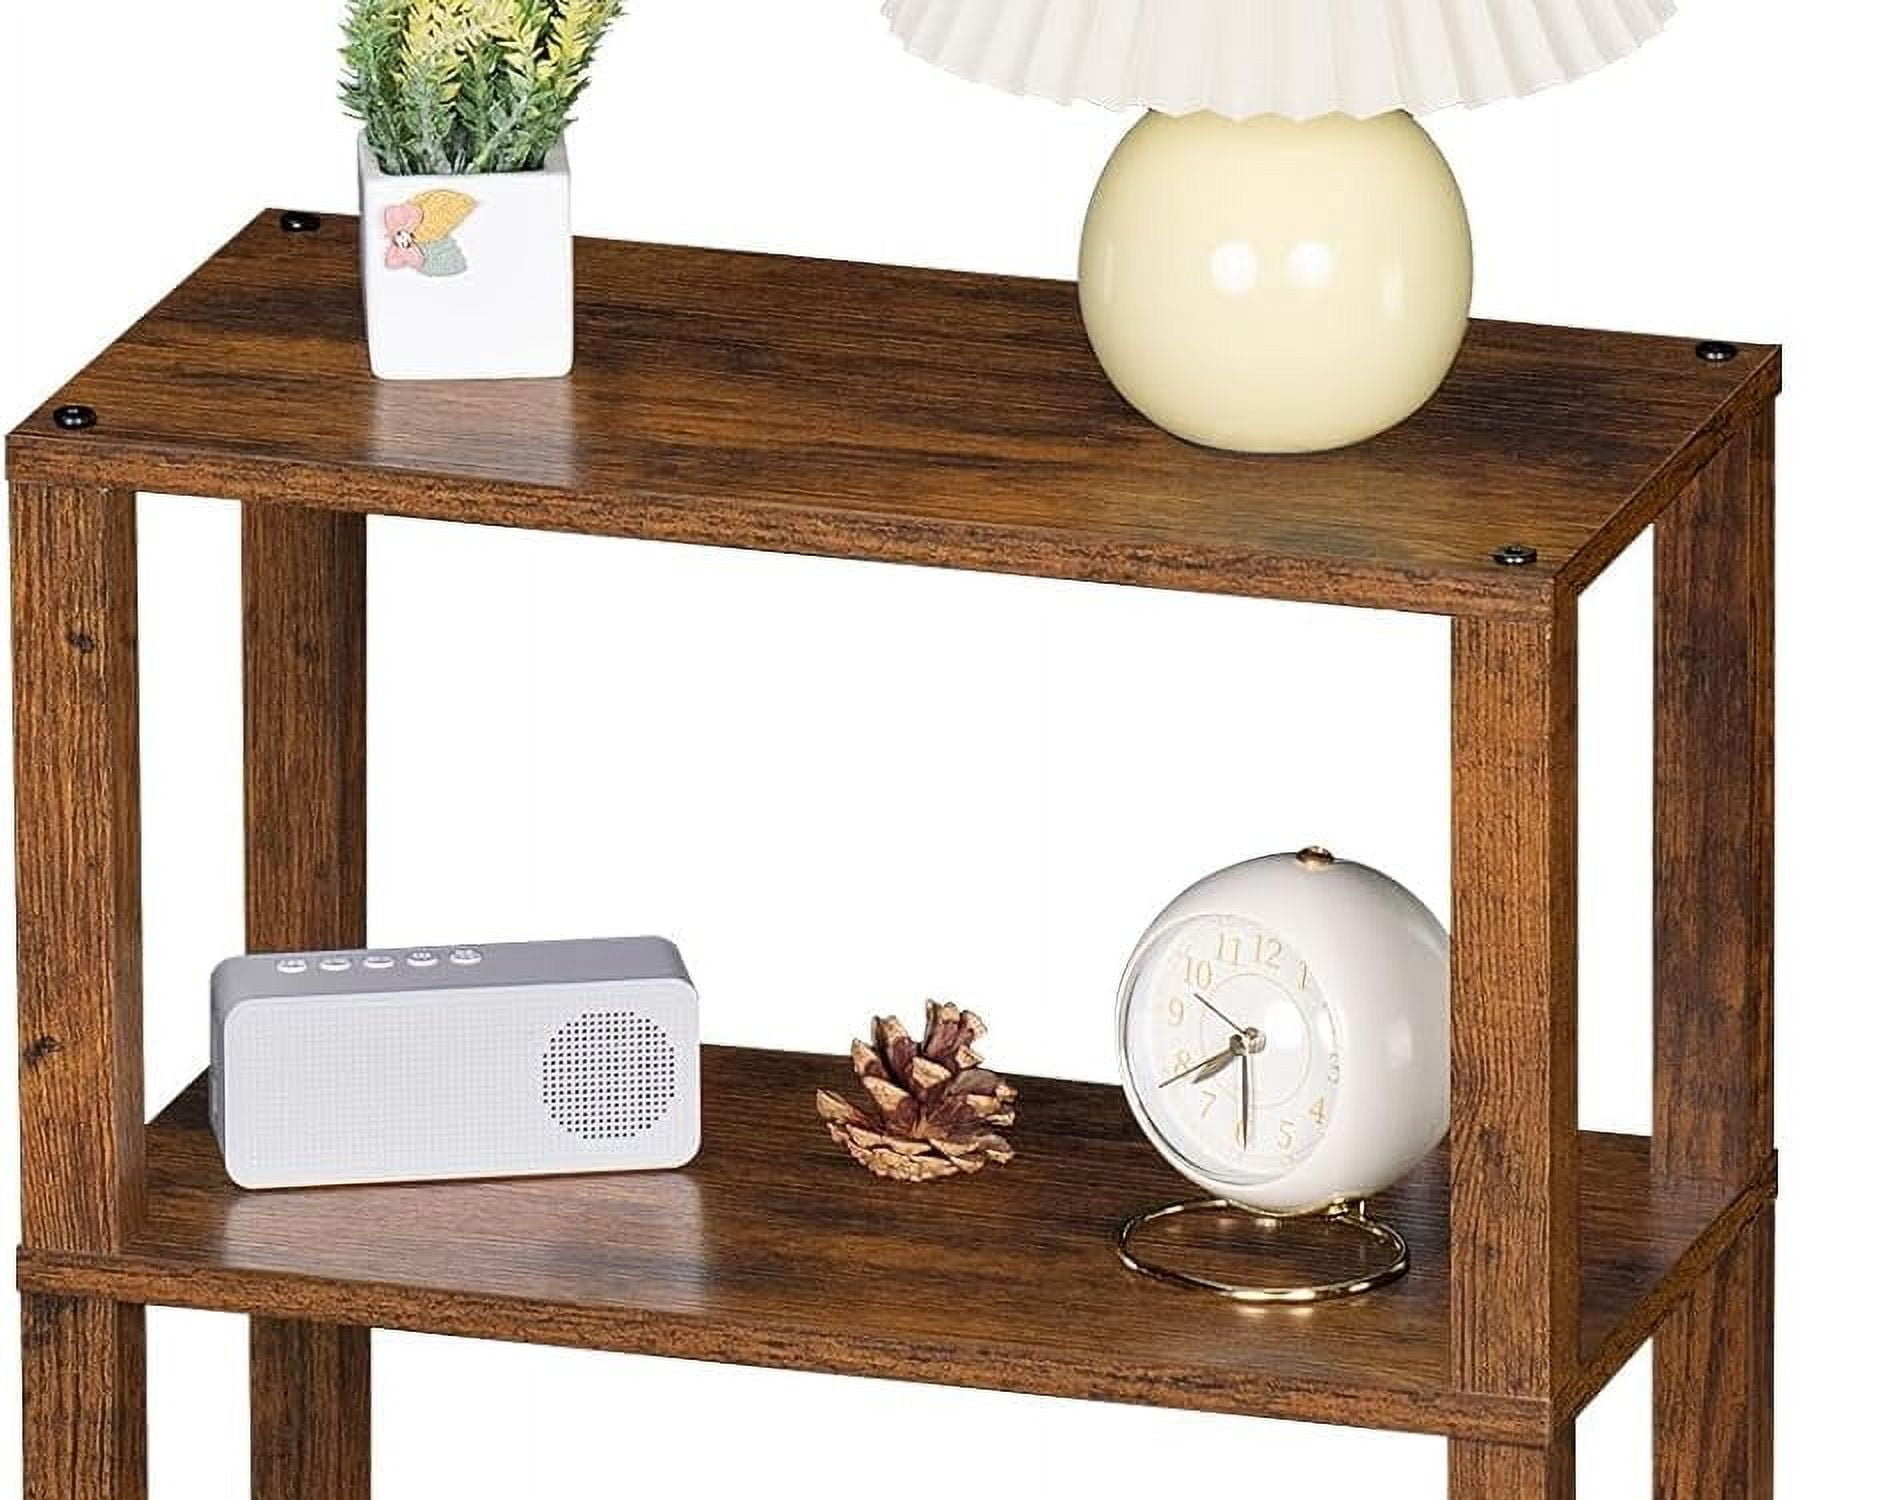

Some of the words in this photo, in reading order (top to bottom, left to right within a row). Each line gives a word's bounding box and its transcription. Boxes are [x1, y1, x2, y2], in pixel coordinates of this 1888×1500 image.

[1217, 933, 1240, 965] 11
[1254, 934, 1281, 969] 12
[1185, 958, 1212, 990] 10
[1168, 999, 1184, 1026] 9
[1328, 1052, 1340, 1084] 3
[1202, 1091, 1217, 1119] 7
[1308, 1096, 1326, 1122] 4
[1278, 1119, 1295, 1149] 5
